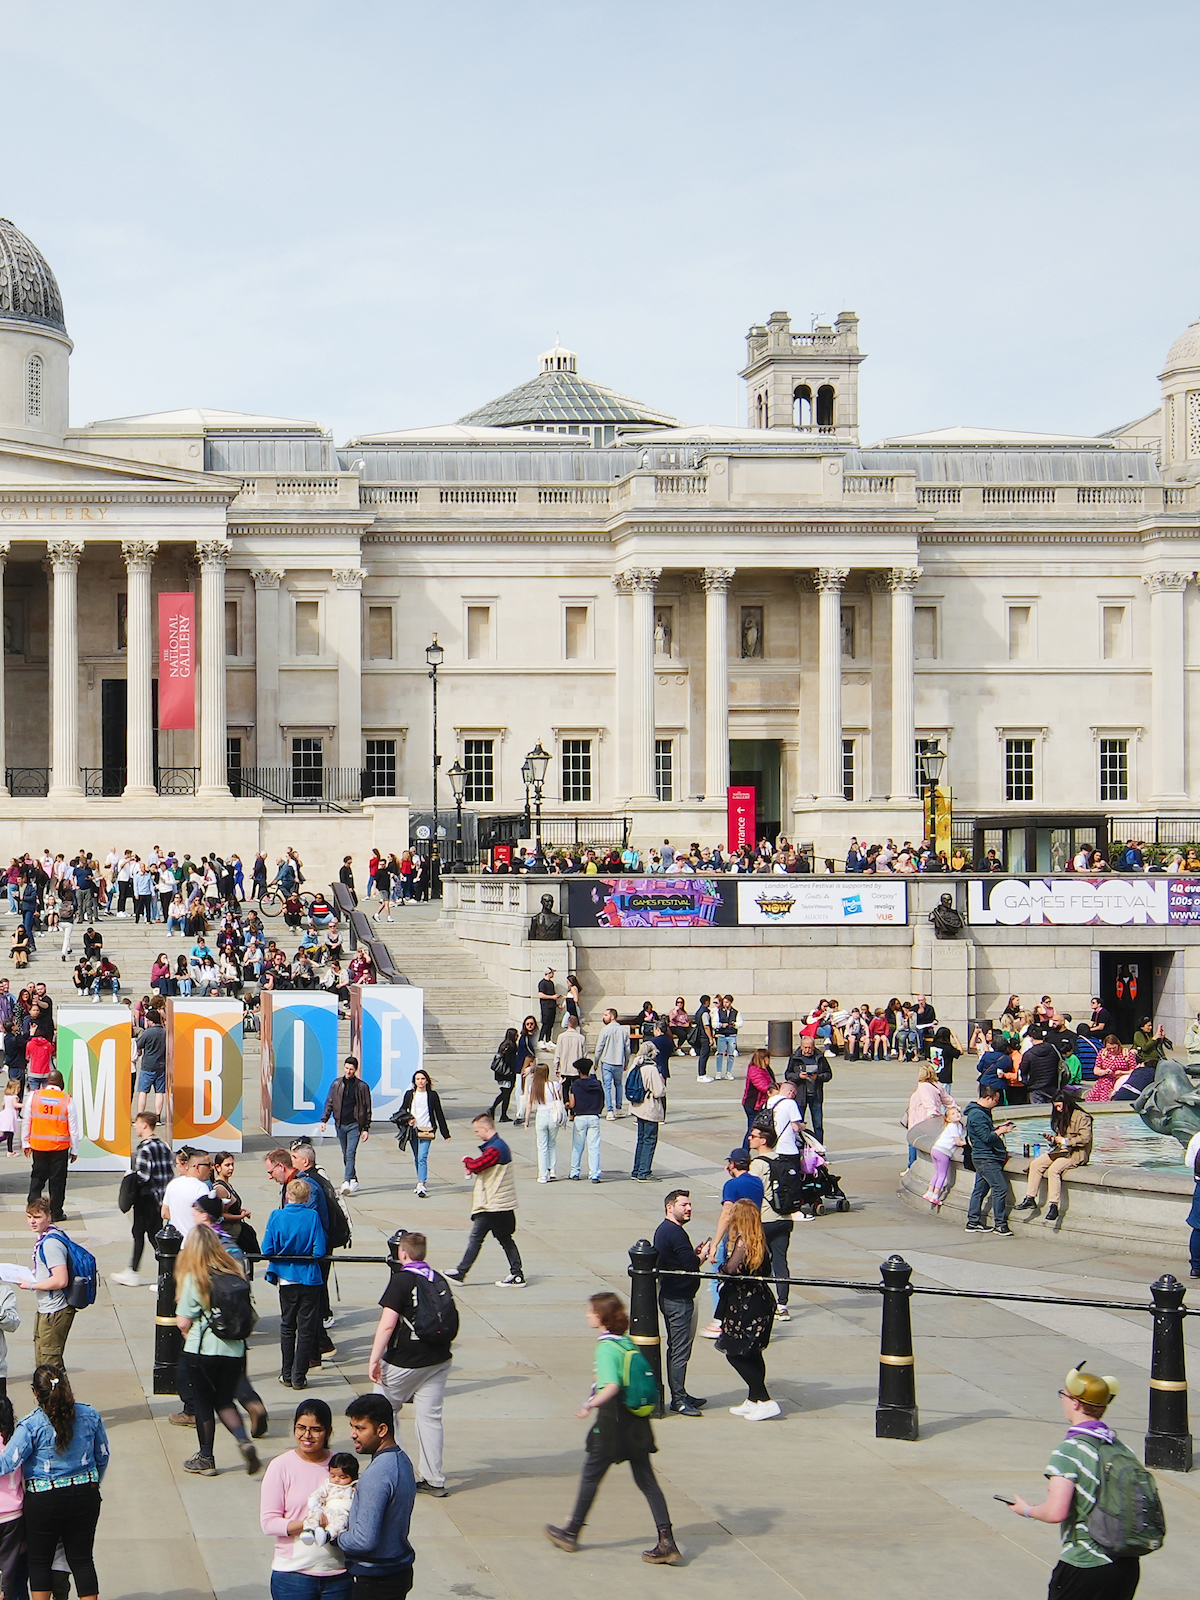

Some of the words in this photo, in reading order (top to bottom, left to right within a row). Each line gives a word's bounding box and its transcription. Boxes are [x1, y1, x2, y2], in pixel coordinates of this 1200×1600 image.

[0, 507, 110, 521] GALLERY
[170, 614, 179, 678] NATIONAL
[180, 614, 191, 678] GALLERY
[737, 817, 746, 853] ntrance
[1170, 884, 1183, 892] 40
[620, 894, 695, 910] LONDON
[968, 880, 1169, 924] LONDON
[1004, 896, 1065, 908] GAMES
[1070, 896, 1156, 908] FESTIVAL
[1170, 896, 1192, 906] 100s
[762, 904, 790, 914] NOW
[43, 1105, 54, 1115] 31
